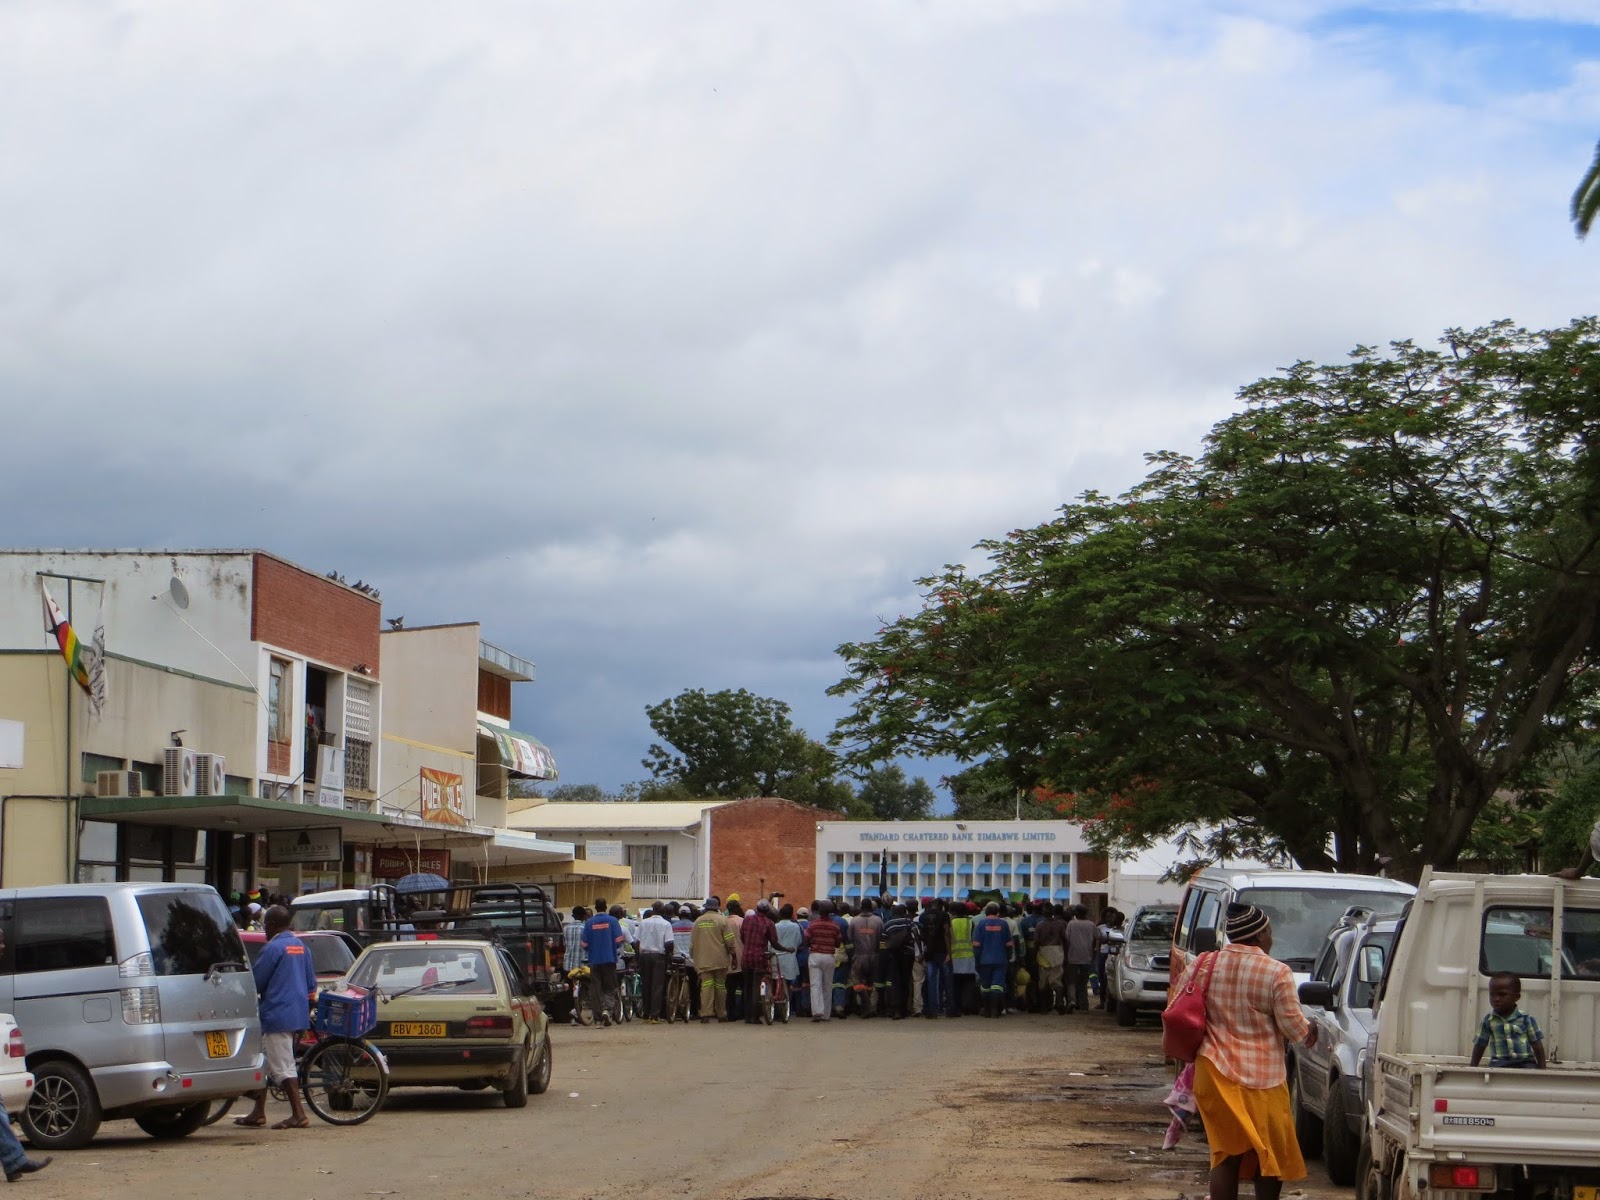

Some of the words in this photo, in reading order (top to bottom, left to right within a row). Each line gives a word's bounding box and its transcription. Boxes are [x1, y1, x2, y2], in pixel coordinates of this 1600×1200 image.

[860, 832, 900, 841] STANDARD
[902, 832, 949, 841] CHARTERED
[952, 832, 973, 841] BANK
[977, 832, 1019, 841] ZIMBABWE
[1022, 832, 1056, 841] LIMITED
[380, 859, 405, 868] POWER
[415, 860, 441, 869] SALES
[393, 1024, 412, 1035] ABV
[418, 1024, 442, 1035] 1860
